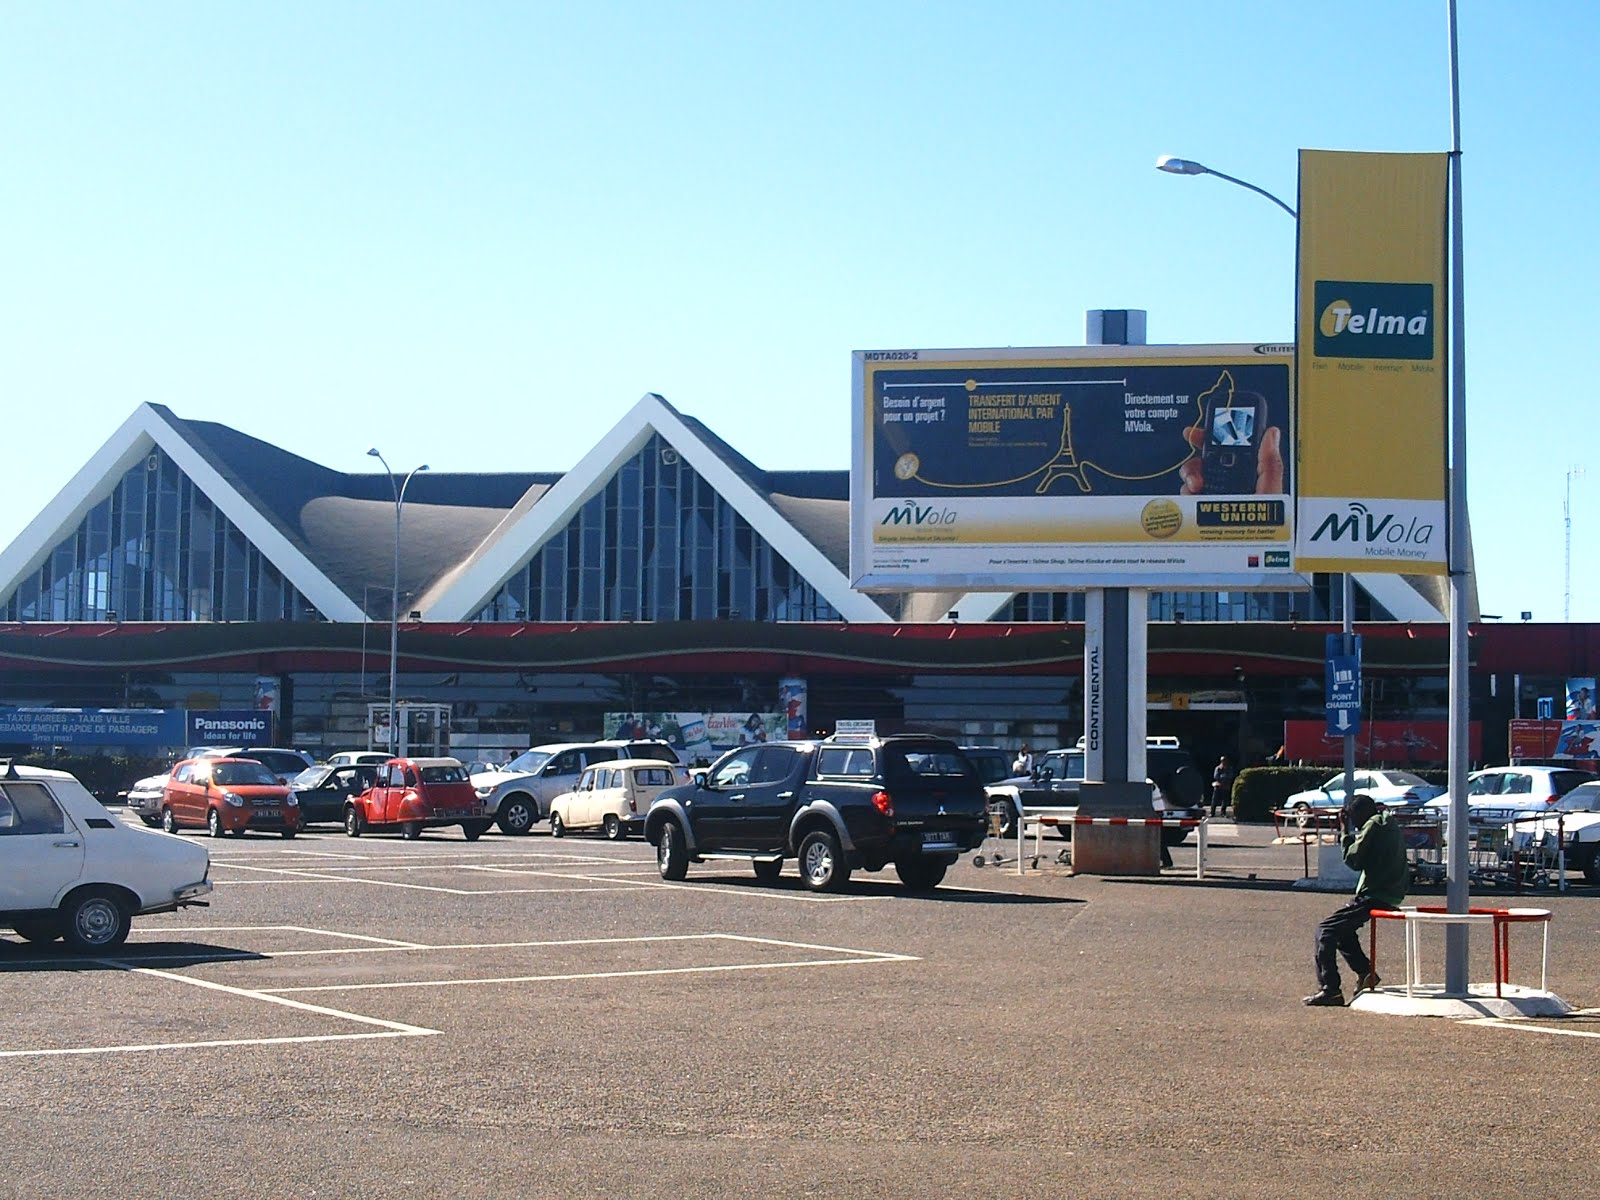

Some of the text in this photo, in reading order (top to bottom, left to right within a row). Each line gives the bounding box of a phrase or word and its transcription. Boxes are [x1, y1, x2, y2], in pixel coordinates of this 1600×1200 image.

[1332, 308, 1427, 335] Telma
[865, 352, 918, 361] MDTA020-2
[883, 396, 945, 411] Besoin d'argent
[968, 393, 1062, 407] TRANSFERT D'ARGENT
[1125, 393, 1189, 405] Directement sur
[883, 413, 901, 424] pour
[902, 412, 914, 422] un
[915, 411, 938, 424] projet
[968, 407, 1053, 420] INTERNATIONAL PAR
[1125, 408, 1178, 420] votre compte
[968, 422, 1000, 433] MOBILE
[1125, 420, 1154, 432] MVola.
[1200, 503, 1267, 513] WESTERN
[881, 506, 957, 525] MVola
[1221, 512, 1267, 522] UNION
[1310, 513, 1433, 544] MVola
[1366, 548, 1427, 558] Mobile Money
[1090, 646, 1099, 750] CONTINENTAL
[1326, 701, 1359, 709] CHARIOTS
[6, 714, 32, 722] TAXIS
[79, 715, 103, 723] TAXIS
[106, 715, 130, 723] VILLE
[195, 718, 266, 730] Panasonic
[62, 724, 92, 733] RAPIDE
[95, 724, 105, 733] DE
[108, 725, 159, 734] PASSAGERS
[228, 732, 241, 740] for
[243, 732, 257, 740] life
